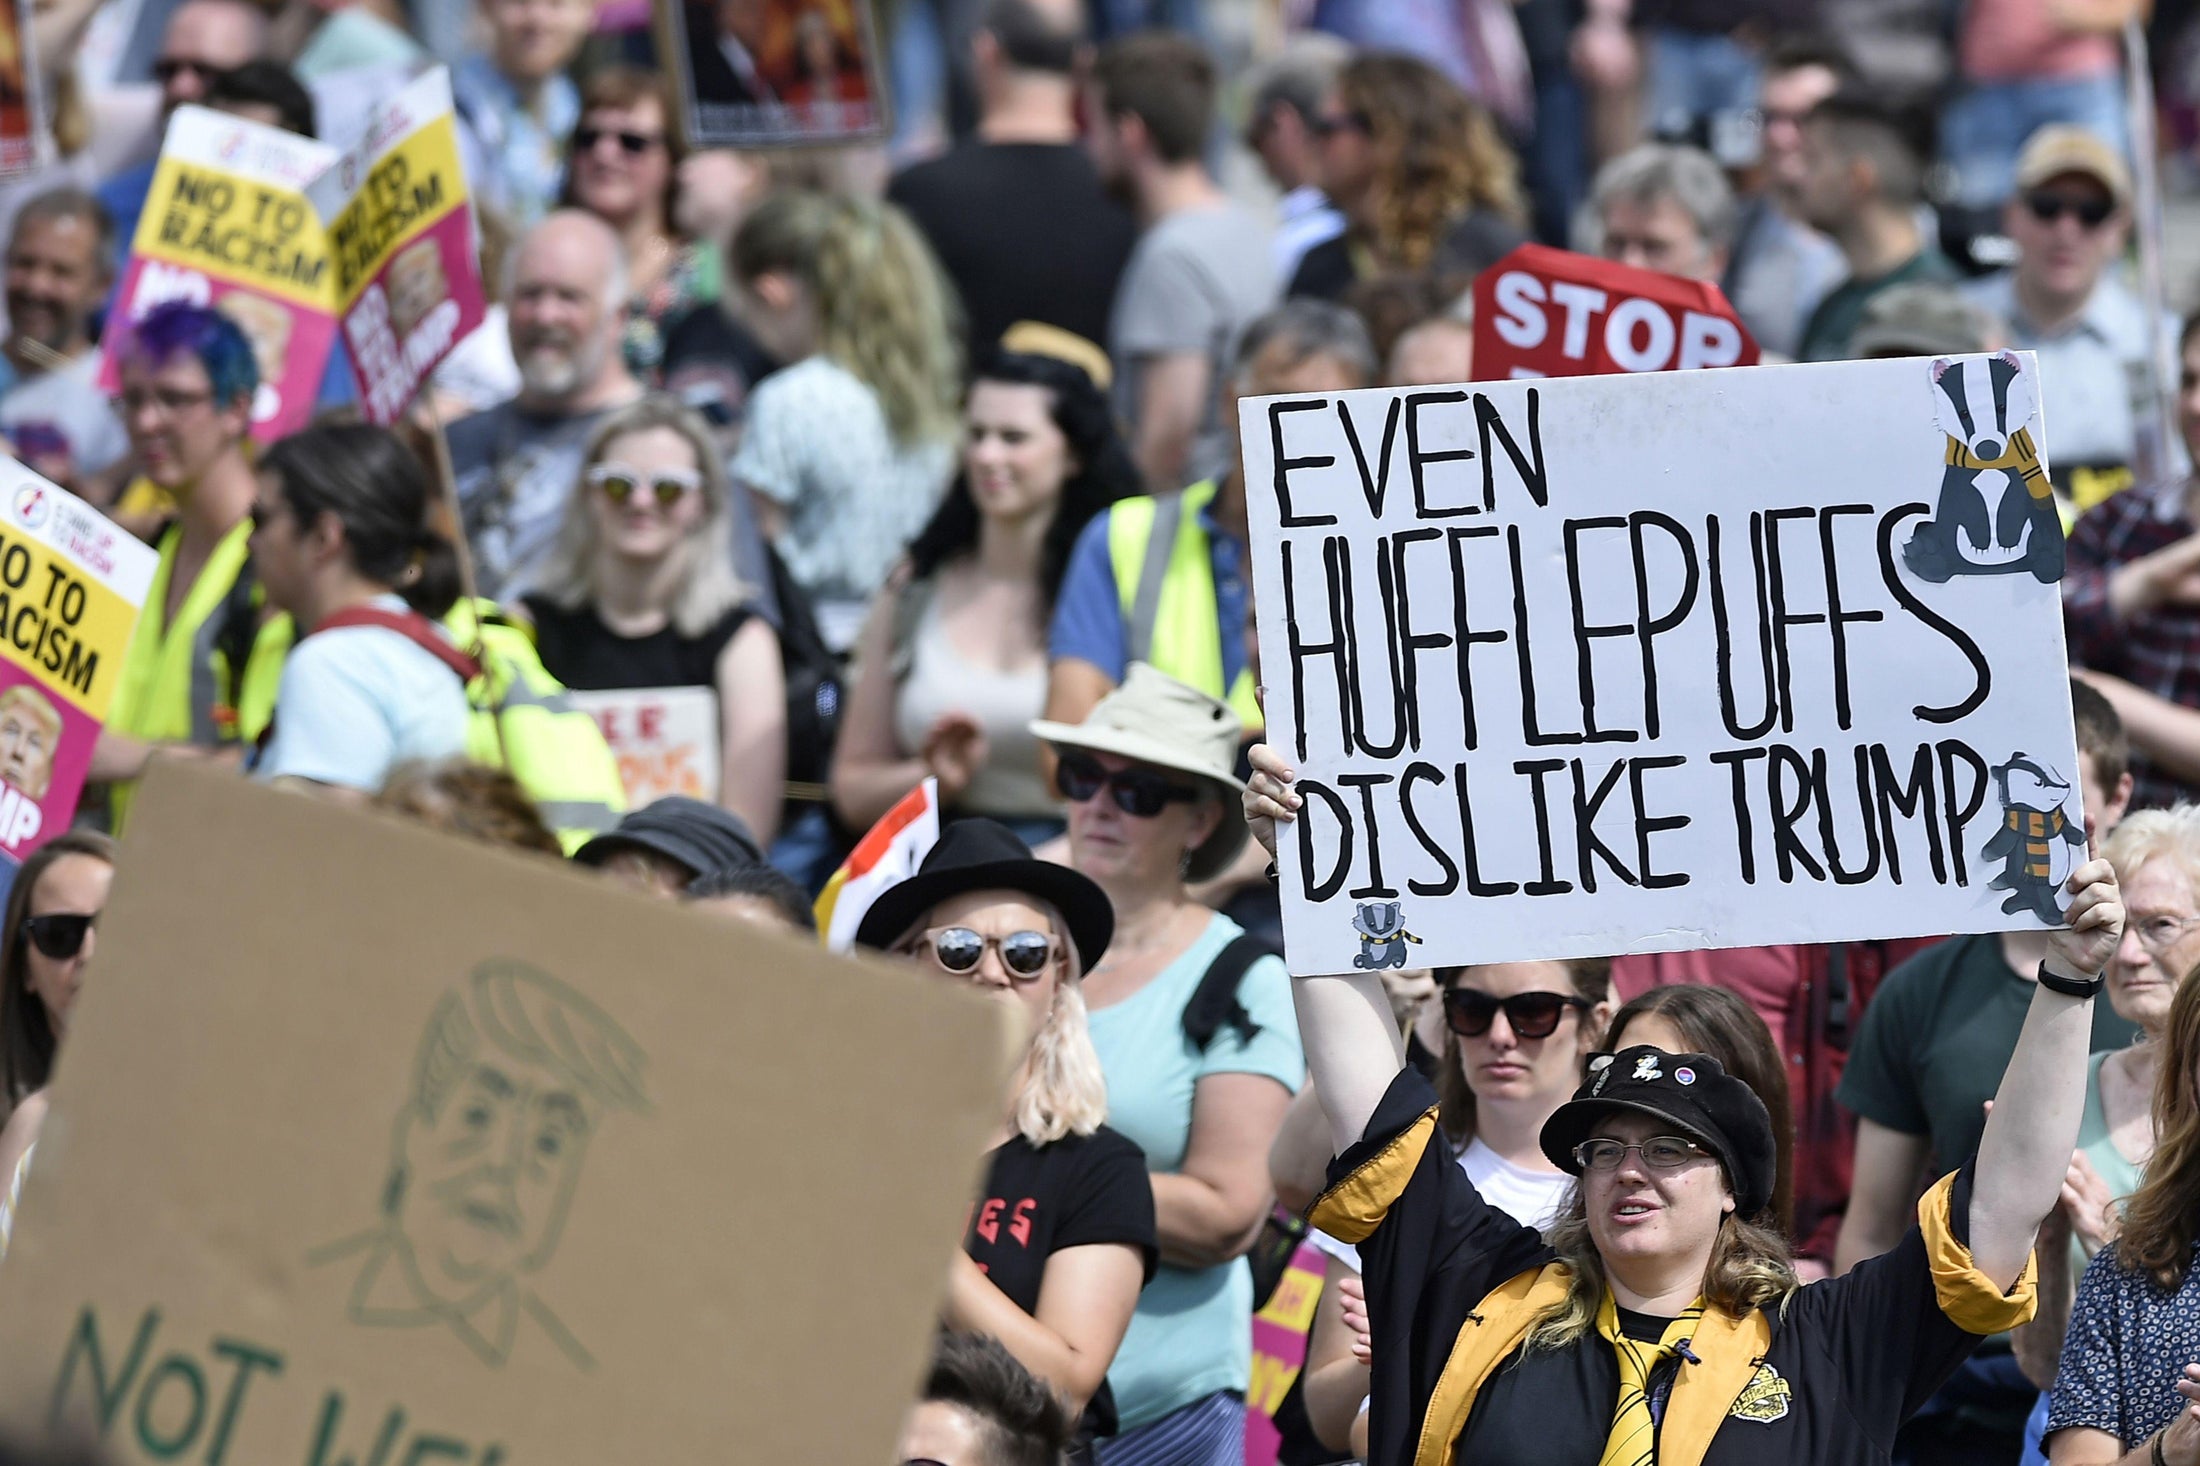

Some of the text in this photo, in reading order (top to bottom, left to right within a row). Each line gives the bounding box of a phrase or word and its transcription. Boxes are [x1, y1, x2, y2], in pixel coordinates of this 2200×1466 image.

[158, 205, 328, 291] RACISM
[171, 173, 305, 237] NO TO
[1493, 270, 1742, 373] STOP
[1268, 387, 1548, 528] EVEN
[46, 563, 87, 627] TO
[1281, 502, 1992, 761] HUFFLEPUFFS
[1294, 738, 1989, 904] DISLIKE TRUMP
[962, 1197, 1037, 1249] ES
[46, 1303, 286, 1466] NOT
